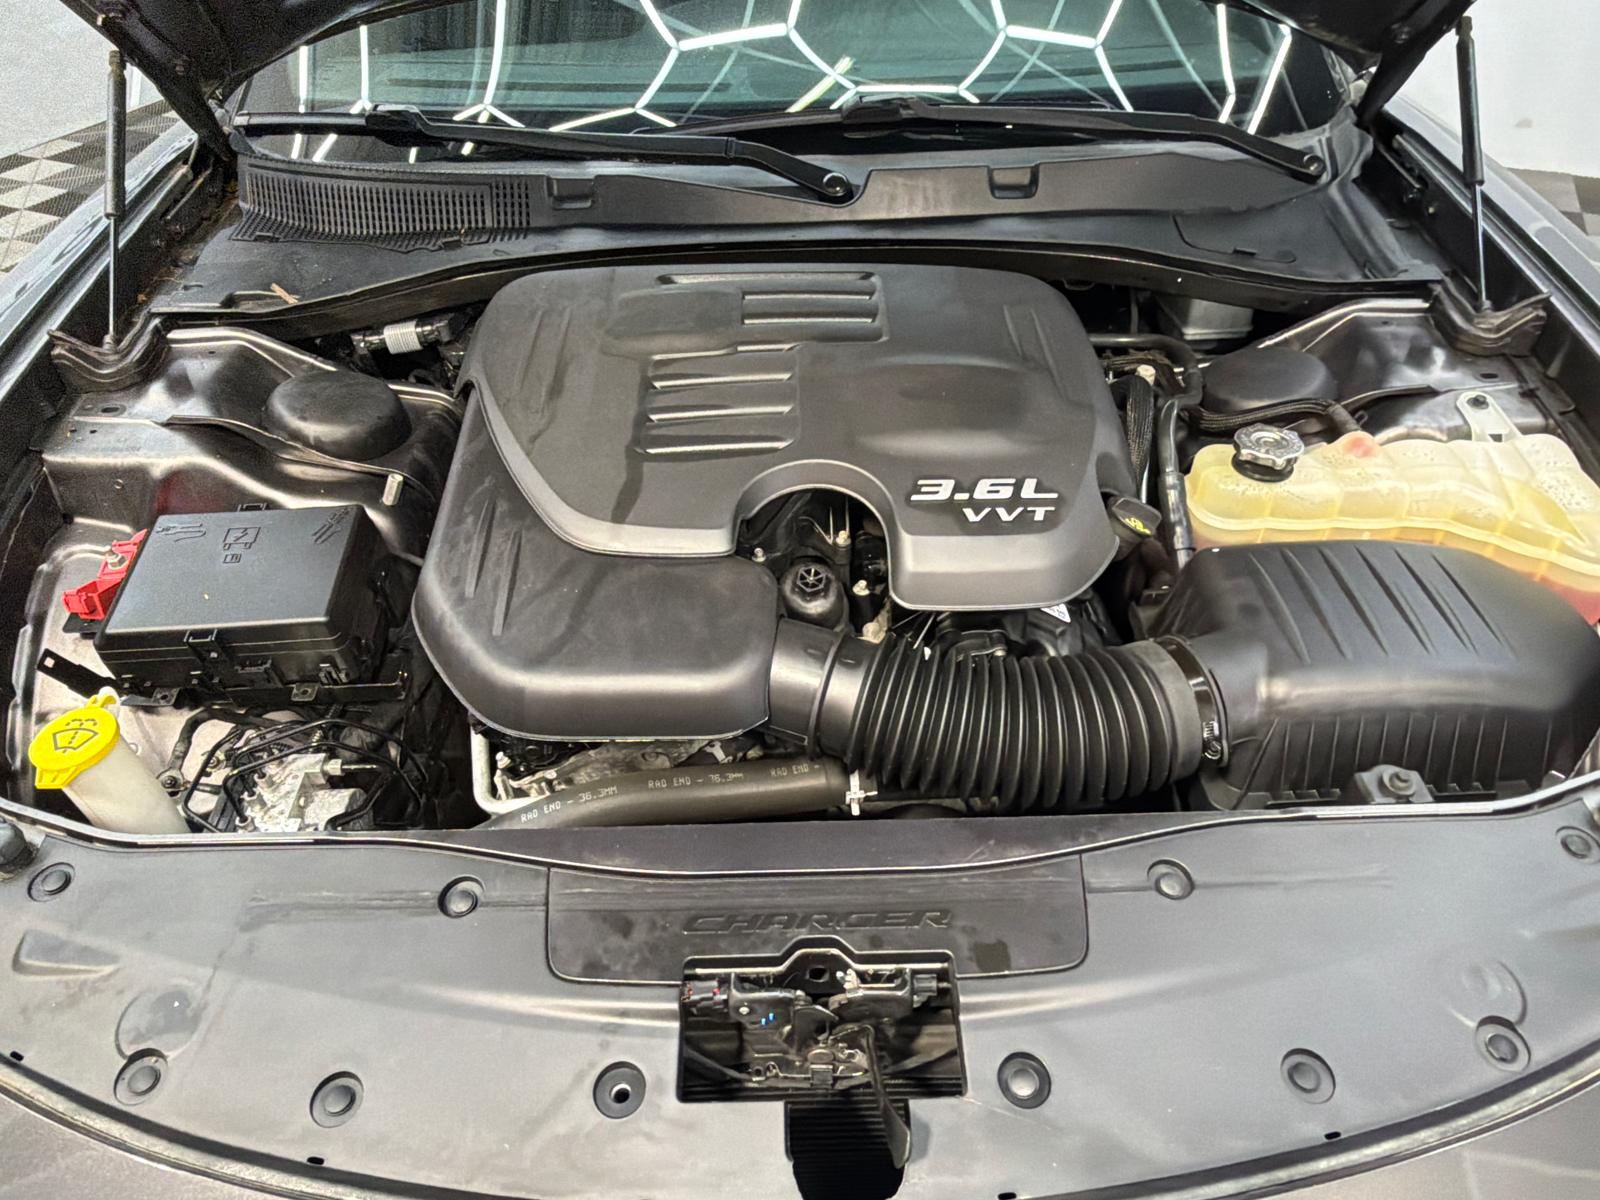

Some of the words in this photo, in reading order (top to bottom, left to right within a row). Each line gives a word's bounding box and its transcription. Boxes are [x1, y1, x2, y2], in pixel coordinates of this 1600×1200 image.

[910, 477, 1059, 501] 3.6L
[962, 506, 1056, 523] VVT
[520, 808, 539, 823] RAD
[543, 800, 562, 814] END
[578, 785, 618, 803] 36.3MM
[647, 778, 668, 789] RAD
[672, 776, 692, 787] END
[769, 766, 788, 777] RAD
[791, 763, 809, 775] END
